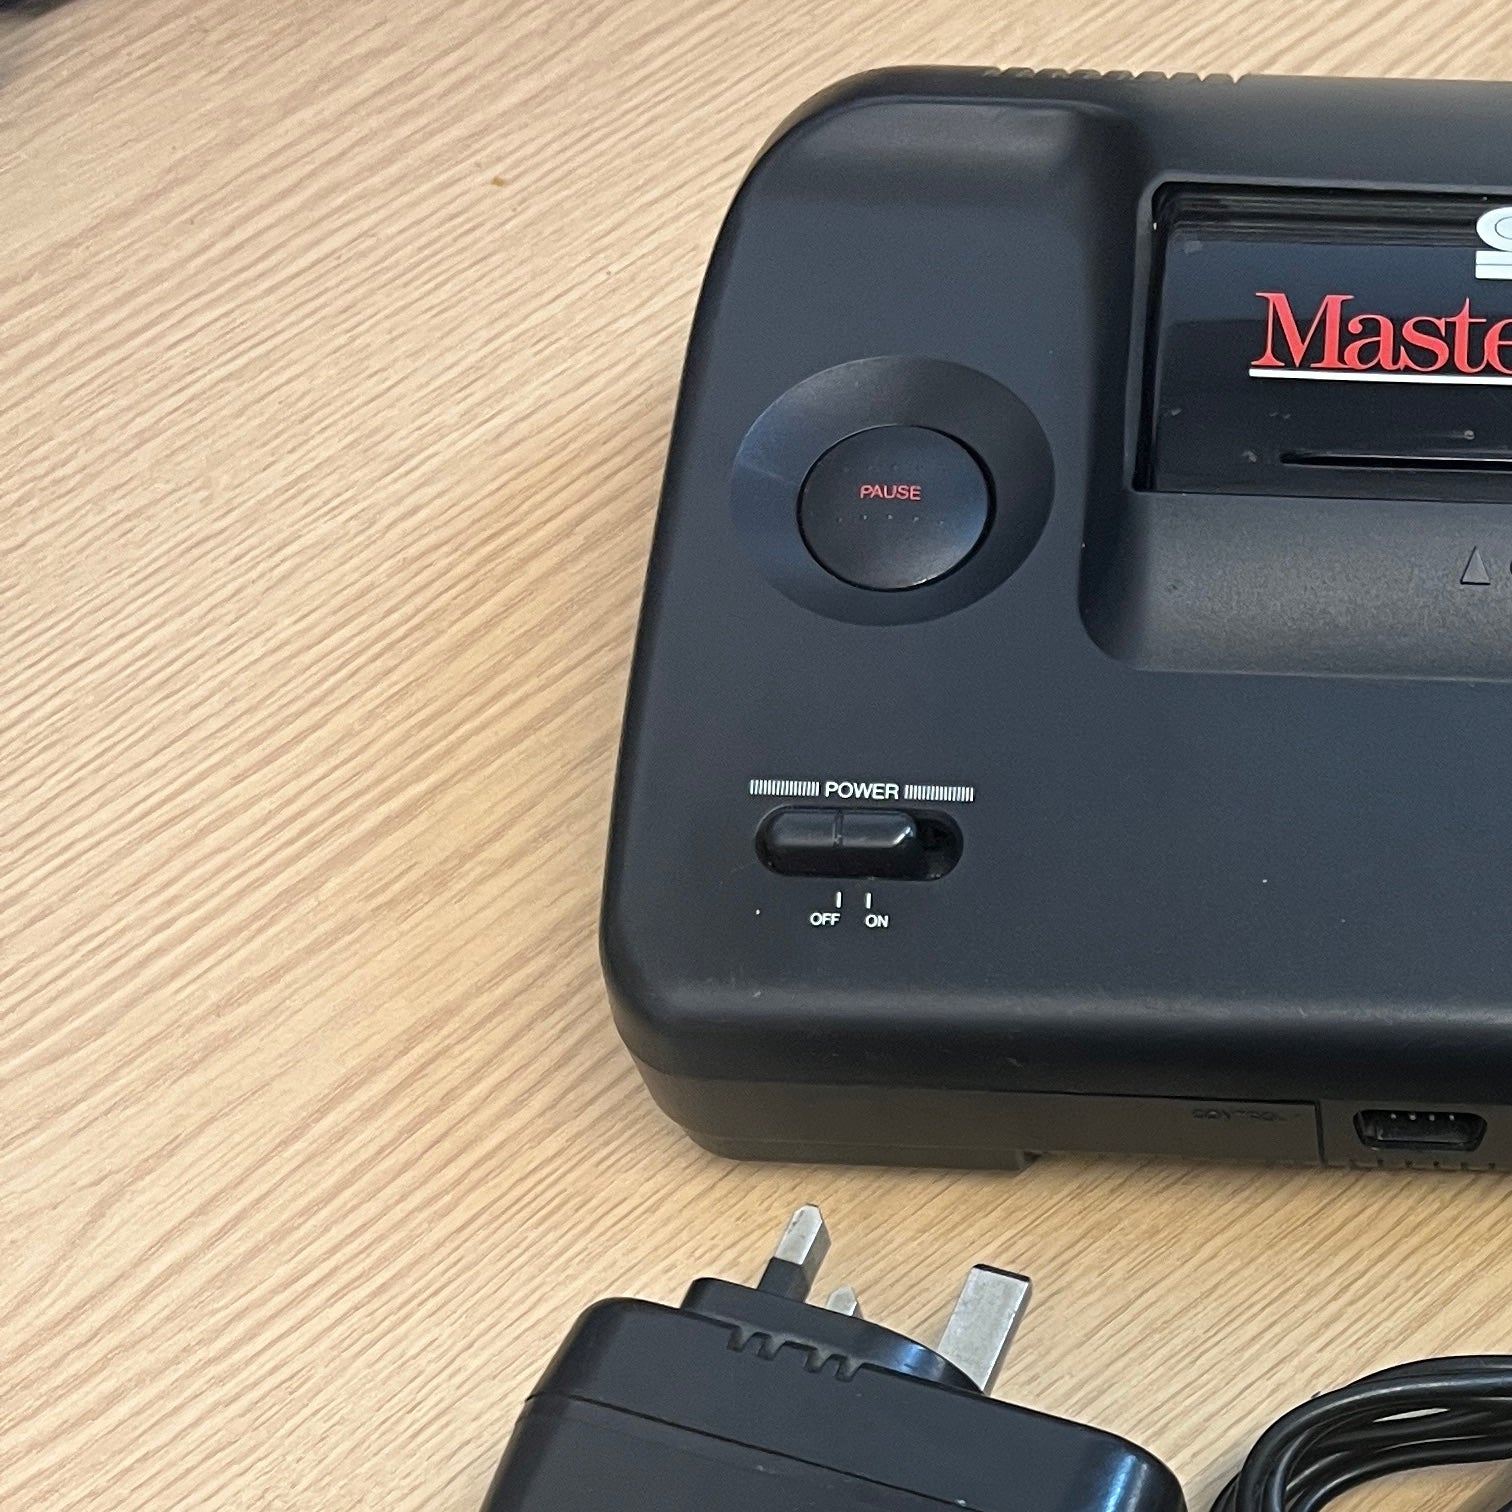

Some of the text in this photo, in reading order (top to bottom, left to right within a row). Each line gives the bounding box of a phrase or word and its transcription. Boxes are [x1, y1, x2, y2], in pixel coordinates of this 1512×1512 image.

[860, 484, 922, 501] PAUSE
[824, 781, 900, 800] POWER
[810, 913, 889, 928] OFF ON
